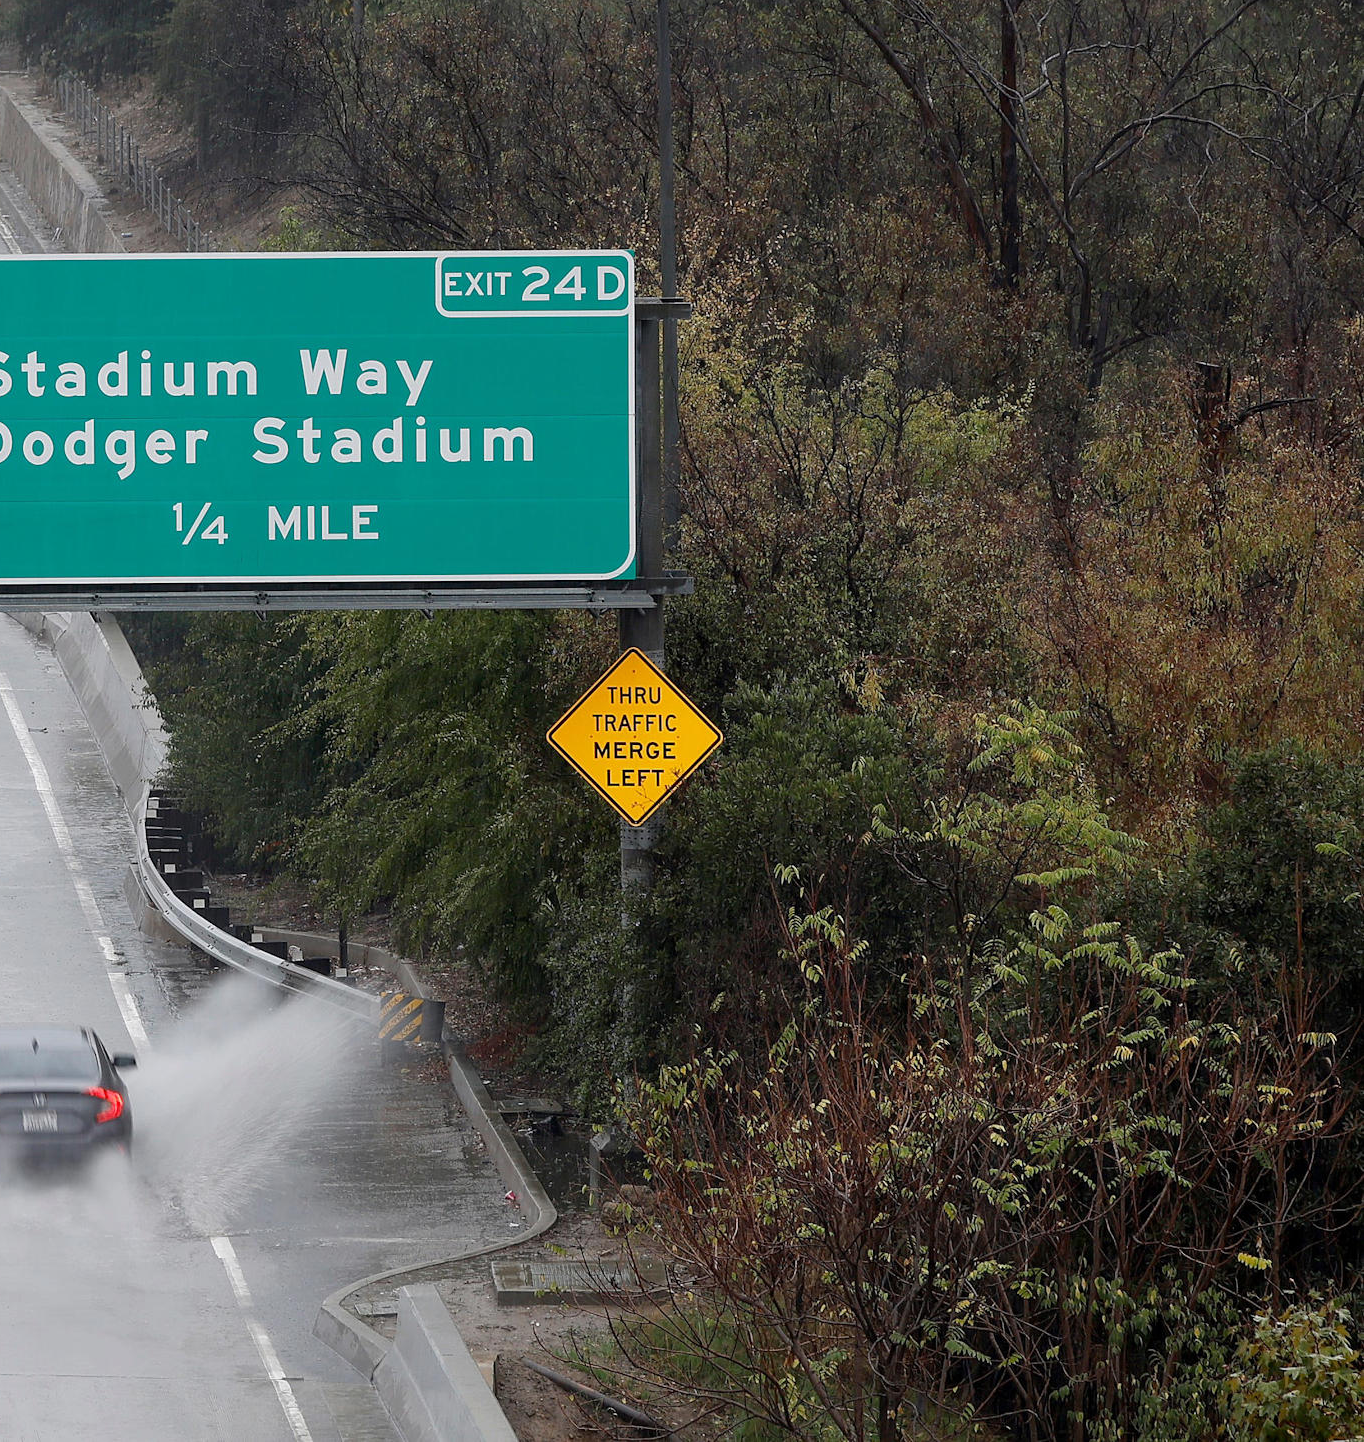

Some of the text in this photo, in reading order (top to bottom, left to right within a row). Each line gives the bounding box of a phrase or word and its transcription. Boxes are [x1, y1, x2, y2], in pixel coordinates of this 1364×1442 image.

[444, 271, 512, 297] EXIT
[299, 348, 434, 407] Way
[252, 415, 534, 464] Stadium
[268, 504, 379, 541] MILE
[607, 686, 662, 705] THRU
[592, 714, 677, 732] TRAFFIC
[594, 741, 676, 760] MERGE
[606, 769, 665, 787] LEFT
